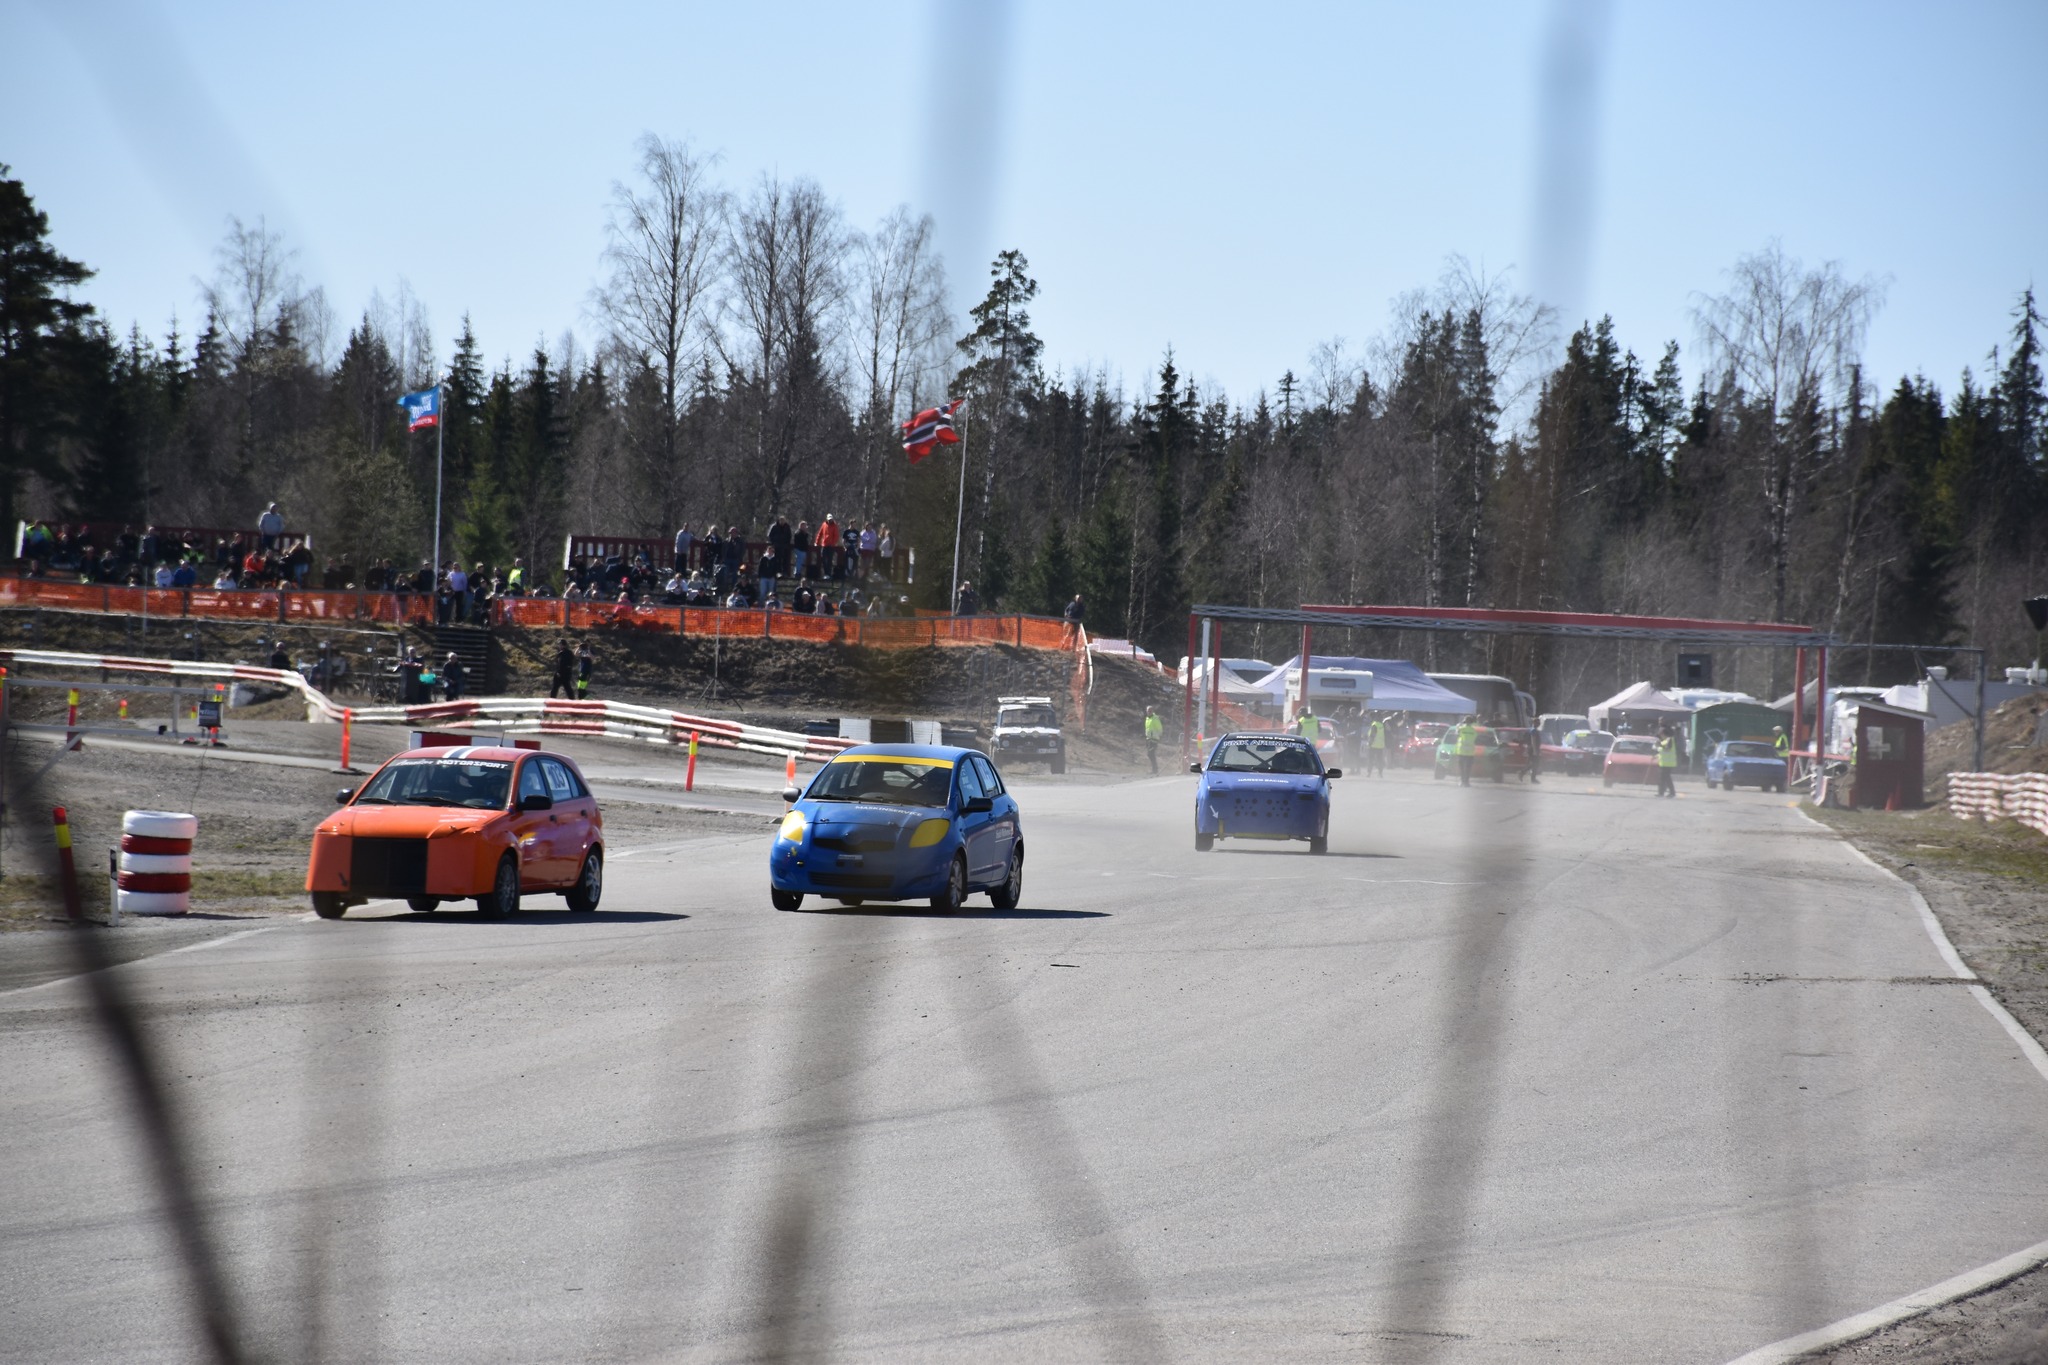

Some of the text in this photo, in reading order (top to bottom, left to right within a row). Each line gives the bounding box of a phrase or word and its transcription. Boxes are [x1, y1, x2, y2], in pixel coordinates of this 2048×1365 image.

[1223, 739, 1306, 749] NMK AREMARK
[436, 759, 508, 769] MOTORSPORT
[855, 805, 922, 817] MASKINSERVICE
